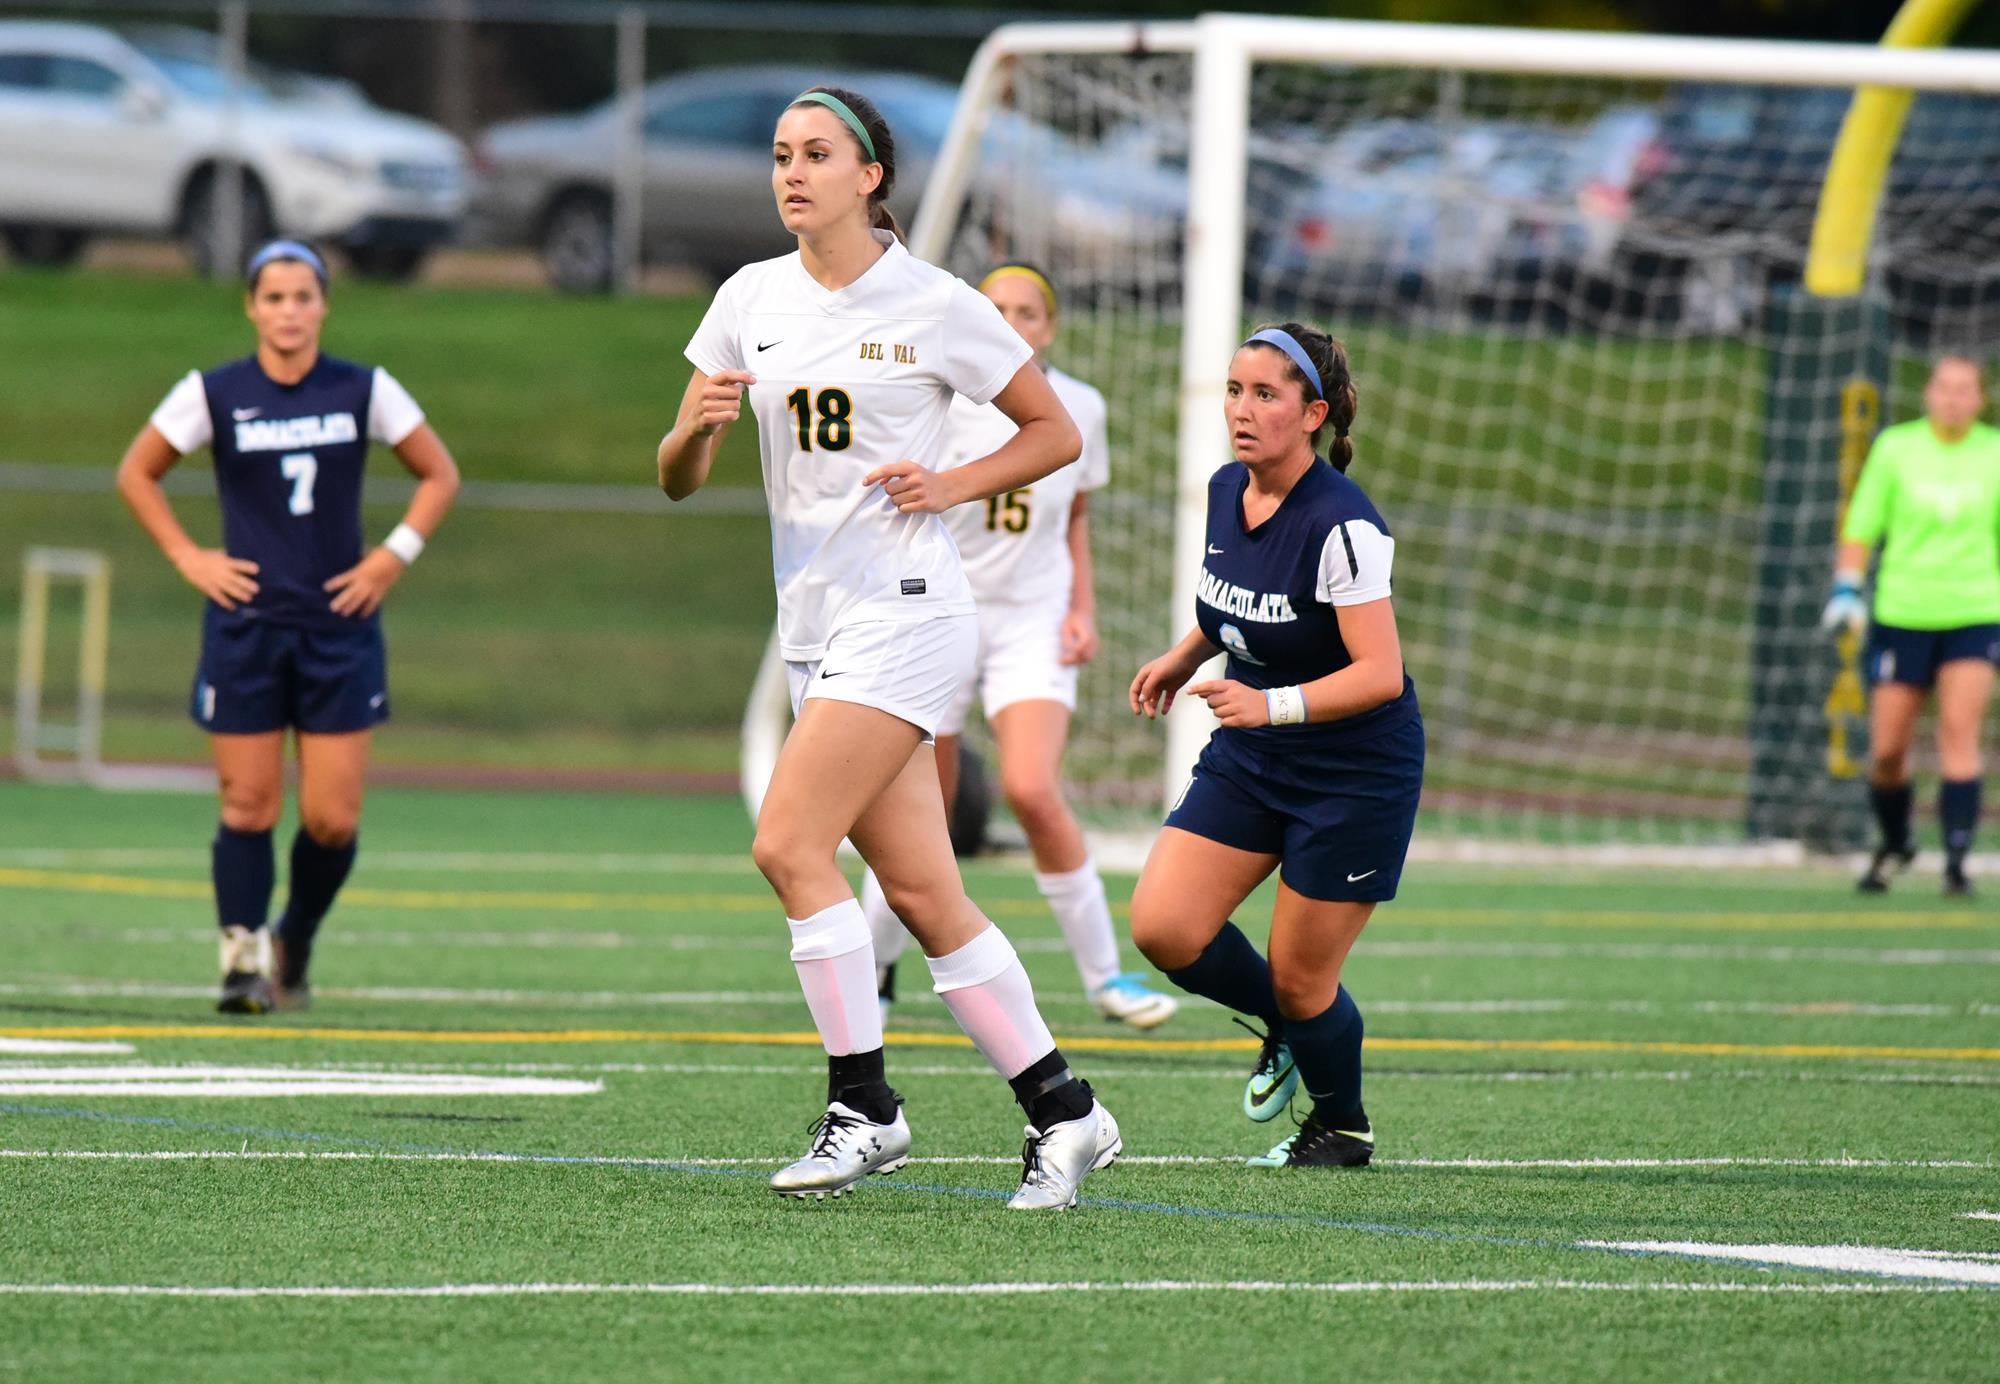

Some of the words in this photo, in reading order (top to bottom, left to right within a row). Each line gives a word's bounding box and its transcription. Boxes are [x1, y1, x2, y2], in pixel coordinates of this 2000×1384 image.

[859, 342, 884, 361] DEL
[893, 343, 918, 365] VAL
[786, 386, 854, 453] 18
[280, 452, 318, 517] 7
[984, 486, 1033, 535] 15
